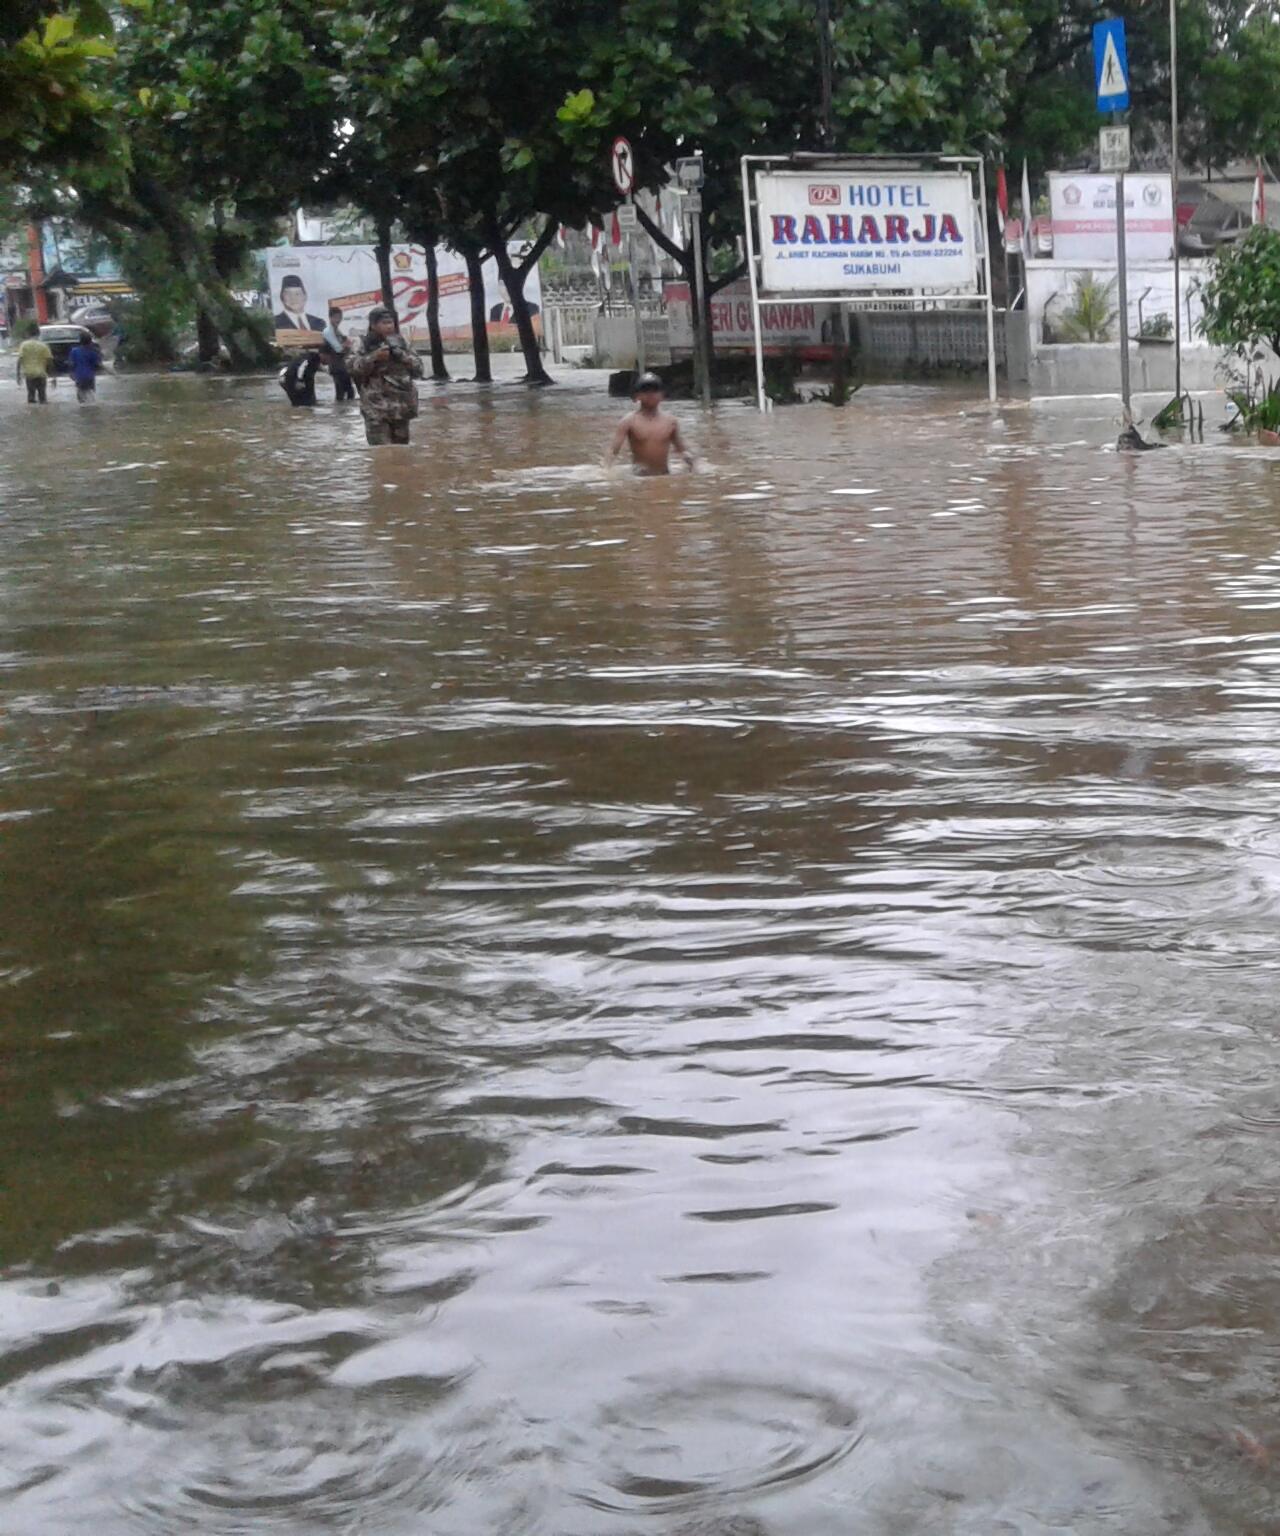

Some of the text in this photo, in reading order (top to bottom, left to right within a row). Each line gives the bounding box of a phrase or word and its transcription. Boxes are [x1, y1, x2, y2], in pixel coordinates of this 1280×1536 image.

[849, 185, 930, 206] HOTEL
[770, 214, 964, 244] RAHARJA
[843, 263, 901, 276] SUKABUMI
[709, 302, 733, 332] ERI
